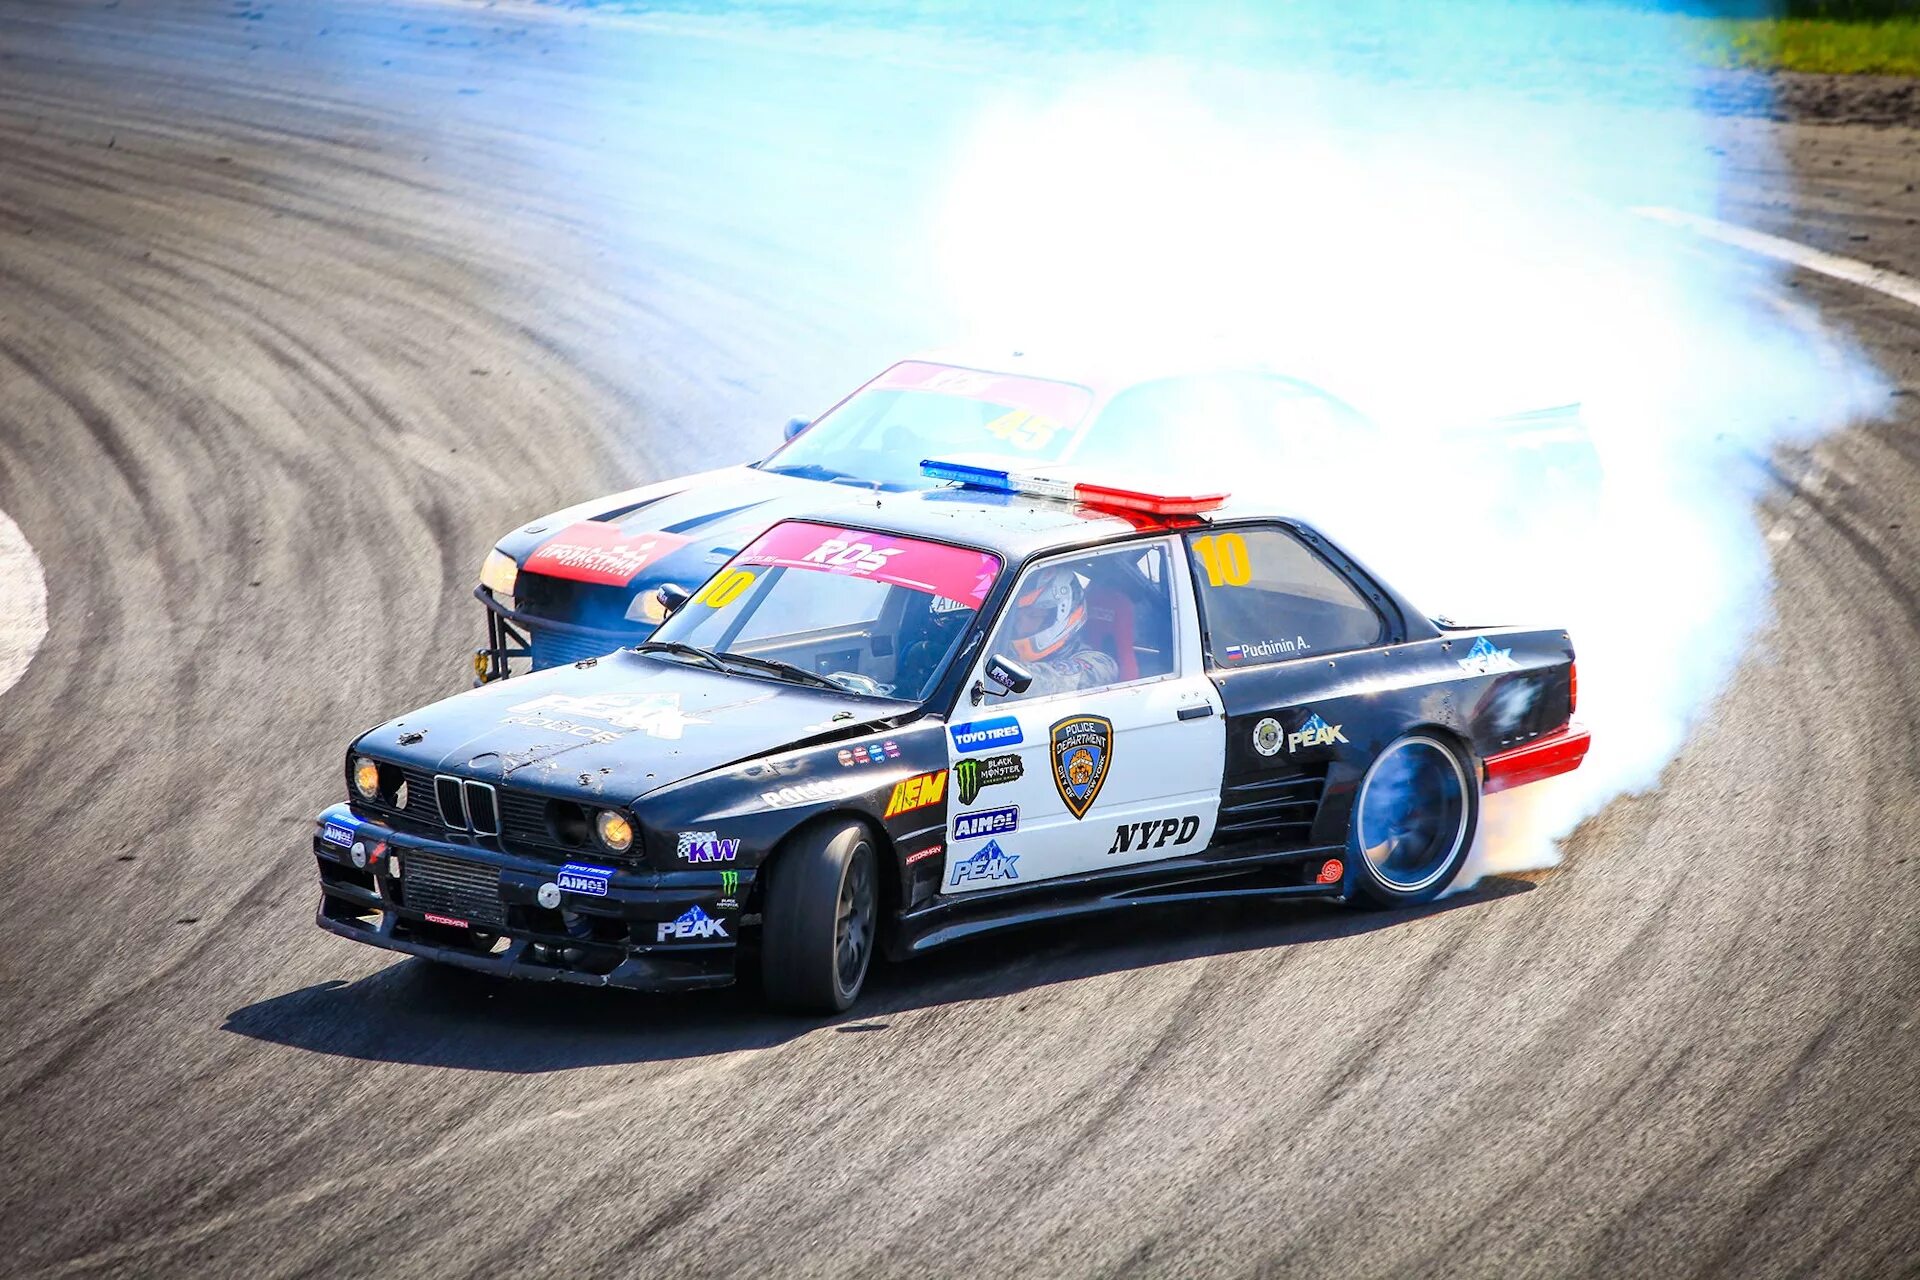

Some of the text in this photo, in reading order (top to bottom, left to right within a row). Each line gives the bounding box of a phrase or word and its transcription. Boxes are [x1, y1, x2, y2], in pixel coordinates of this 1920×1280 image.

[984, 409, 1057, 450] 45
[802, 539, 906, 575] RDS
[1191, 532, 1252, 587] 10
[696, 567, 757, 609] 10
[1241, 635, 1311, 658] Puchinin A.
[956, 725, 1019, 744] TOYO TIRES
[1056, 733, 1107, 754] DEPARTMENT
[1065, 722, 1096, 737] POLICE
[1288, 724, 1350, 753] PEAK
[981, 764, 1021, 779] MONSTER
[988, 757, 1013, 769] BLACK
[1083, 755, 1106, 799] NEW YORK
[884, 770, 948, 819] AEM
[1058, 765, 1076, 798] CITY OF
[1107, 815, 1200, 855] NYPD
[688, 838, 741, 863] KW
[906, 846, 942, 865] MOTORMAN
[950, 855, 1020, 886] PEAK
[657, 918, 730, 941] PEAK
